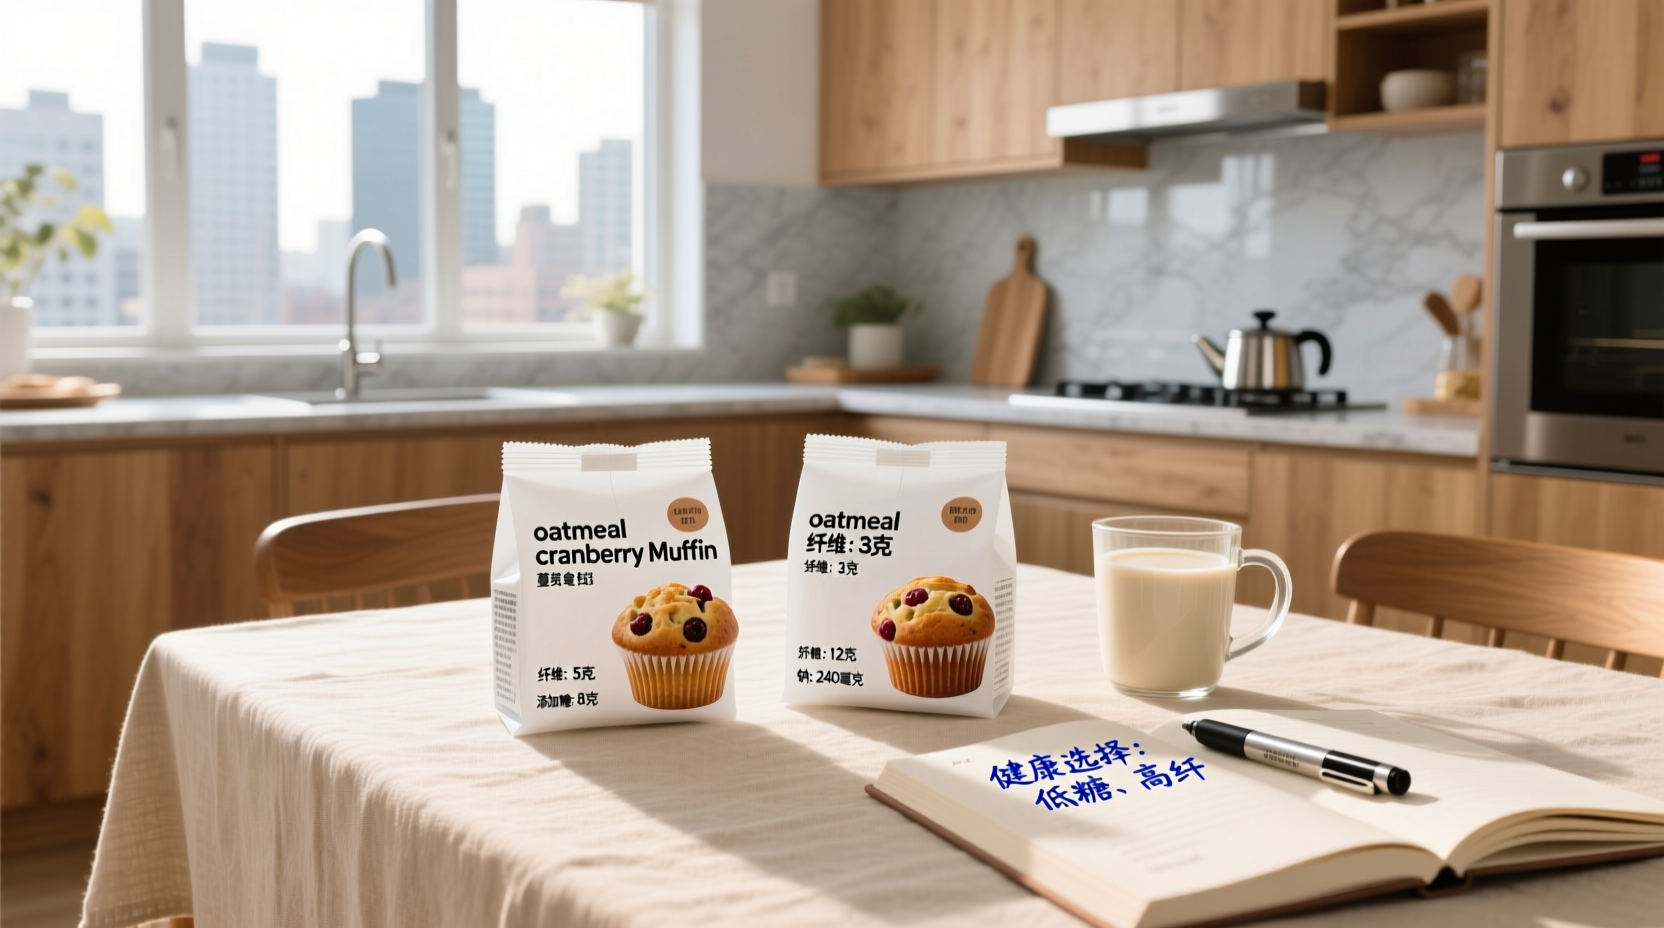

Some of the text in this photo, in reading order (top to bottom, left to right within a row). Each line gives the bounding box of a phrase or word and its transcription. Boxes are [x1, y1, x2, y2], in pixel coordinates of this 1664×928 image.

[533, 518, 627, 541] oatmeal
[809, 511, 901, 531] oatmeal
[535, 538, 718, 568] cranberry Muffin
[805, 532, 893, 557] 纤维：3克
[990, 739, 1145, 789] 健康选择：
[1035, 756, 1205, 811] 低糖、高纤
